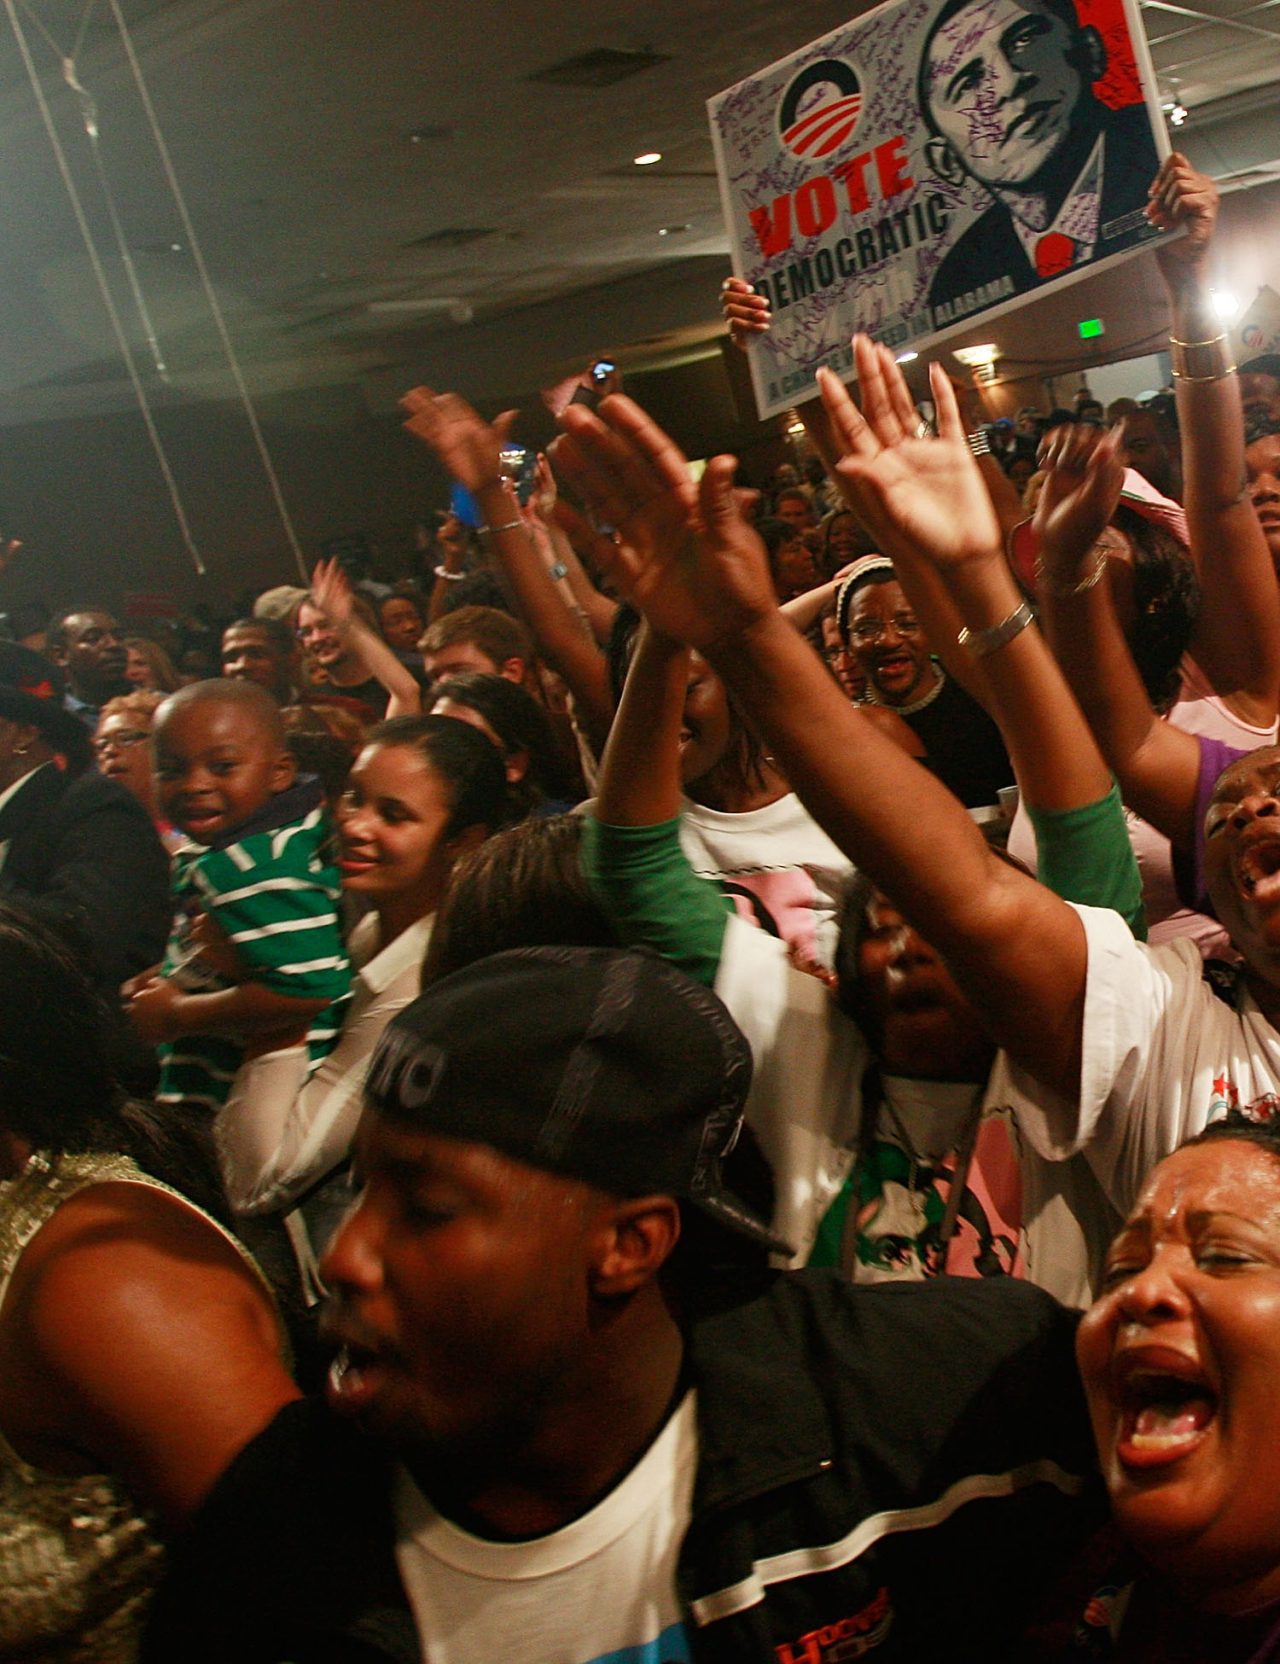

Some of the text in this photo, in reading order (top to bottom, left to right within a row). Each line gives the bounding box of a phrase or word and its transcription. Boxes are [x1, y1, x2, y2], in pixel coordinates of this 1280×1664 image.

[748, 134, 917, 258] VOTE
[754, 193, 949, 311] DEMOCRATIC
[934, 275, 1015, 326] ALABAMA
